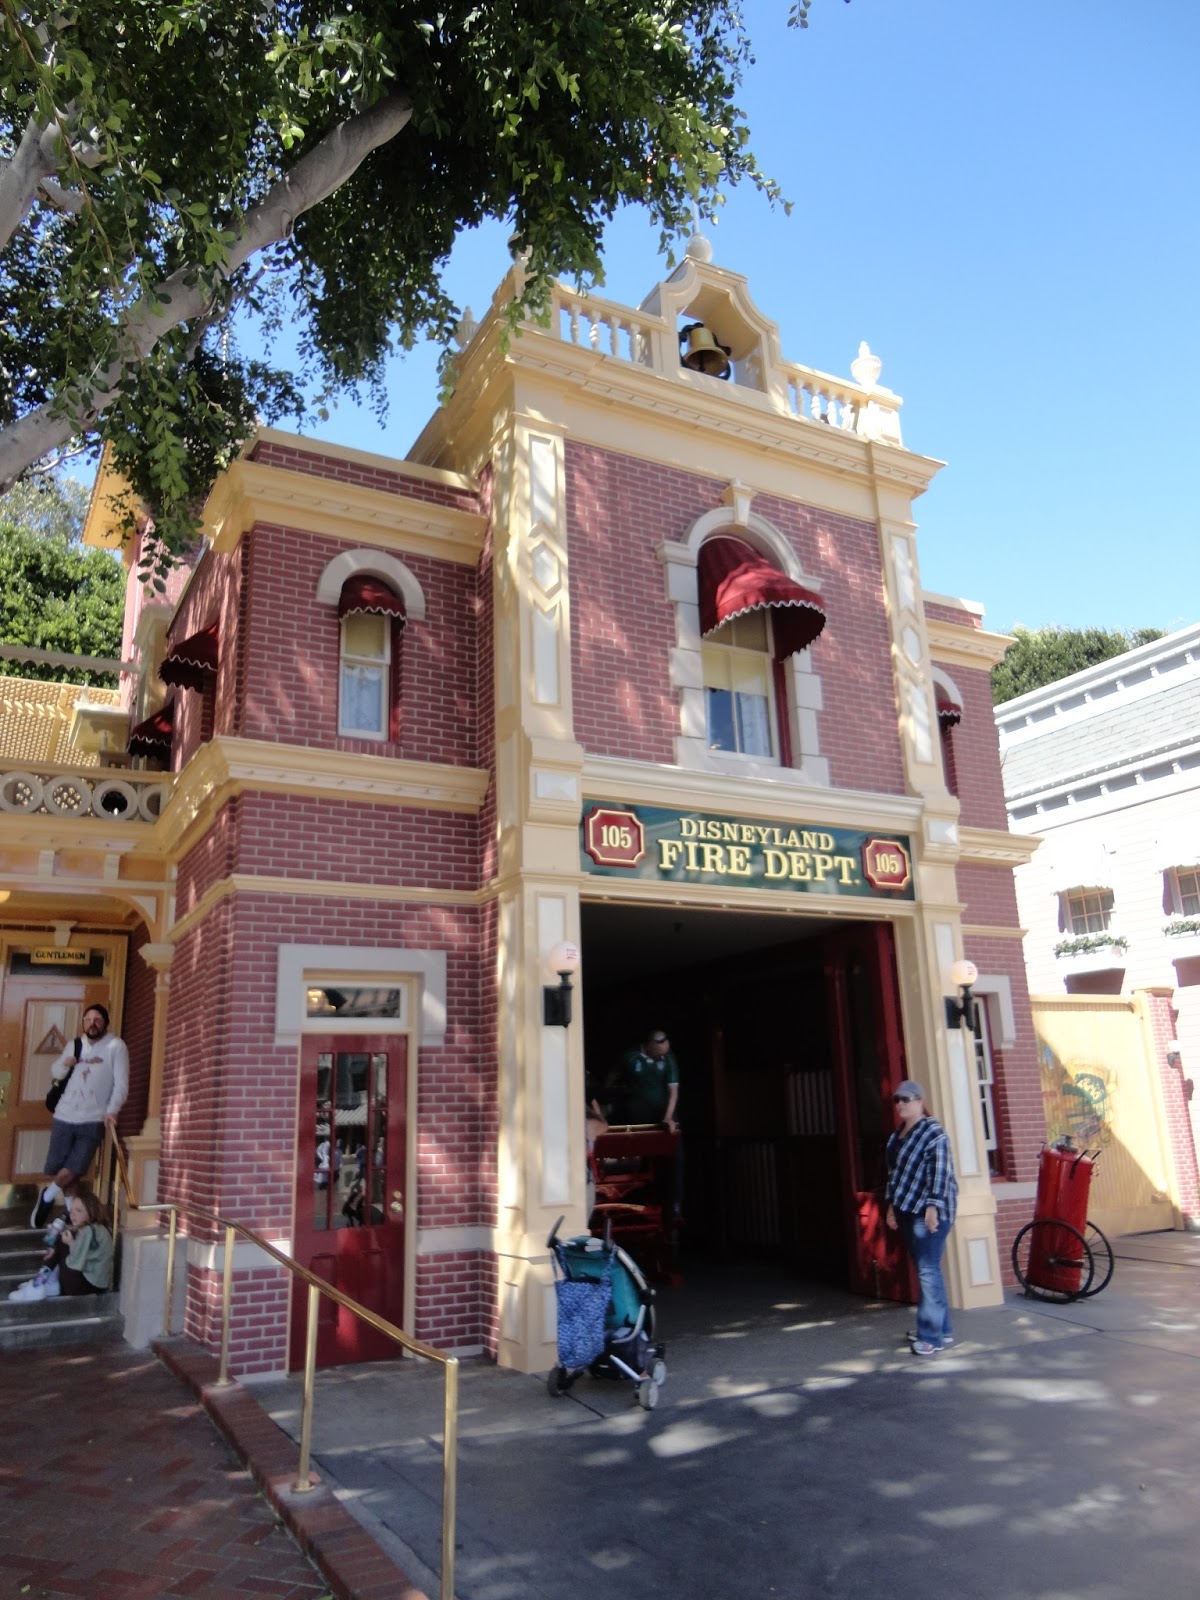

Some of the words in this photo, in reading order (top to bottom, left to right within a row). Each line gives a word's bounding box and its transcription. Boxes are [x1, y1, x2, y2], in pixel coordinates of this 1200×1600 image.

[600, 824, 632, 849] 105
[679, 817, 835, 851] DISNEYLAND
[657, 838, 751, 877] FIRE
[764, 850, 861, 885] DEPT.
[875, 853, 899, 874] 105
[35, 950, 86, 961] GENTLEMEN
